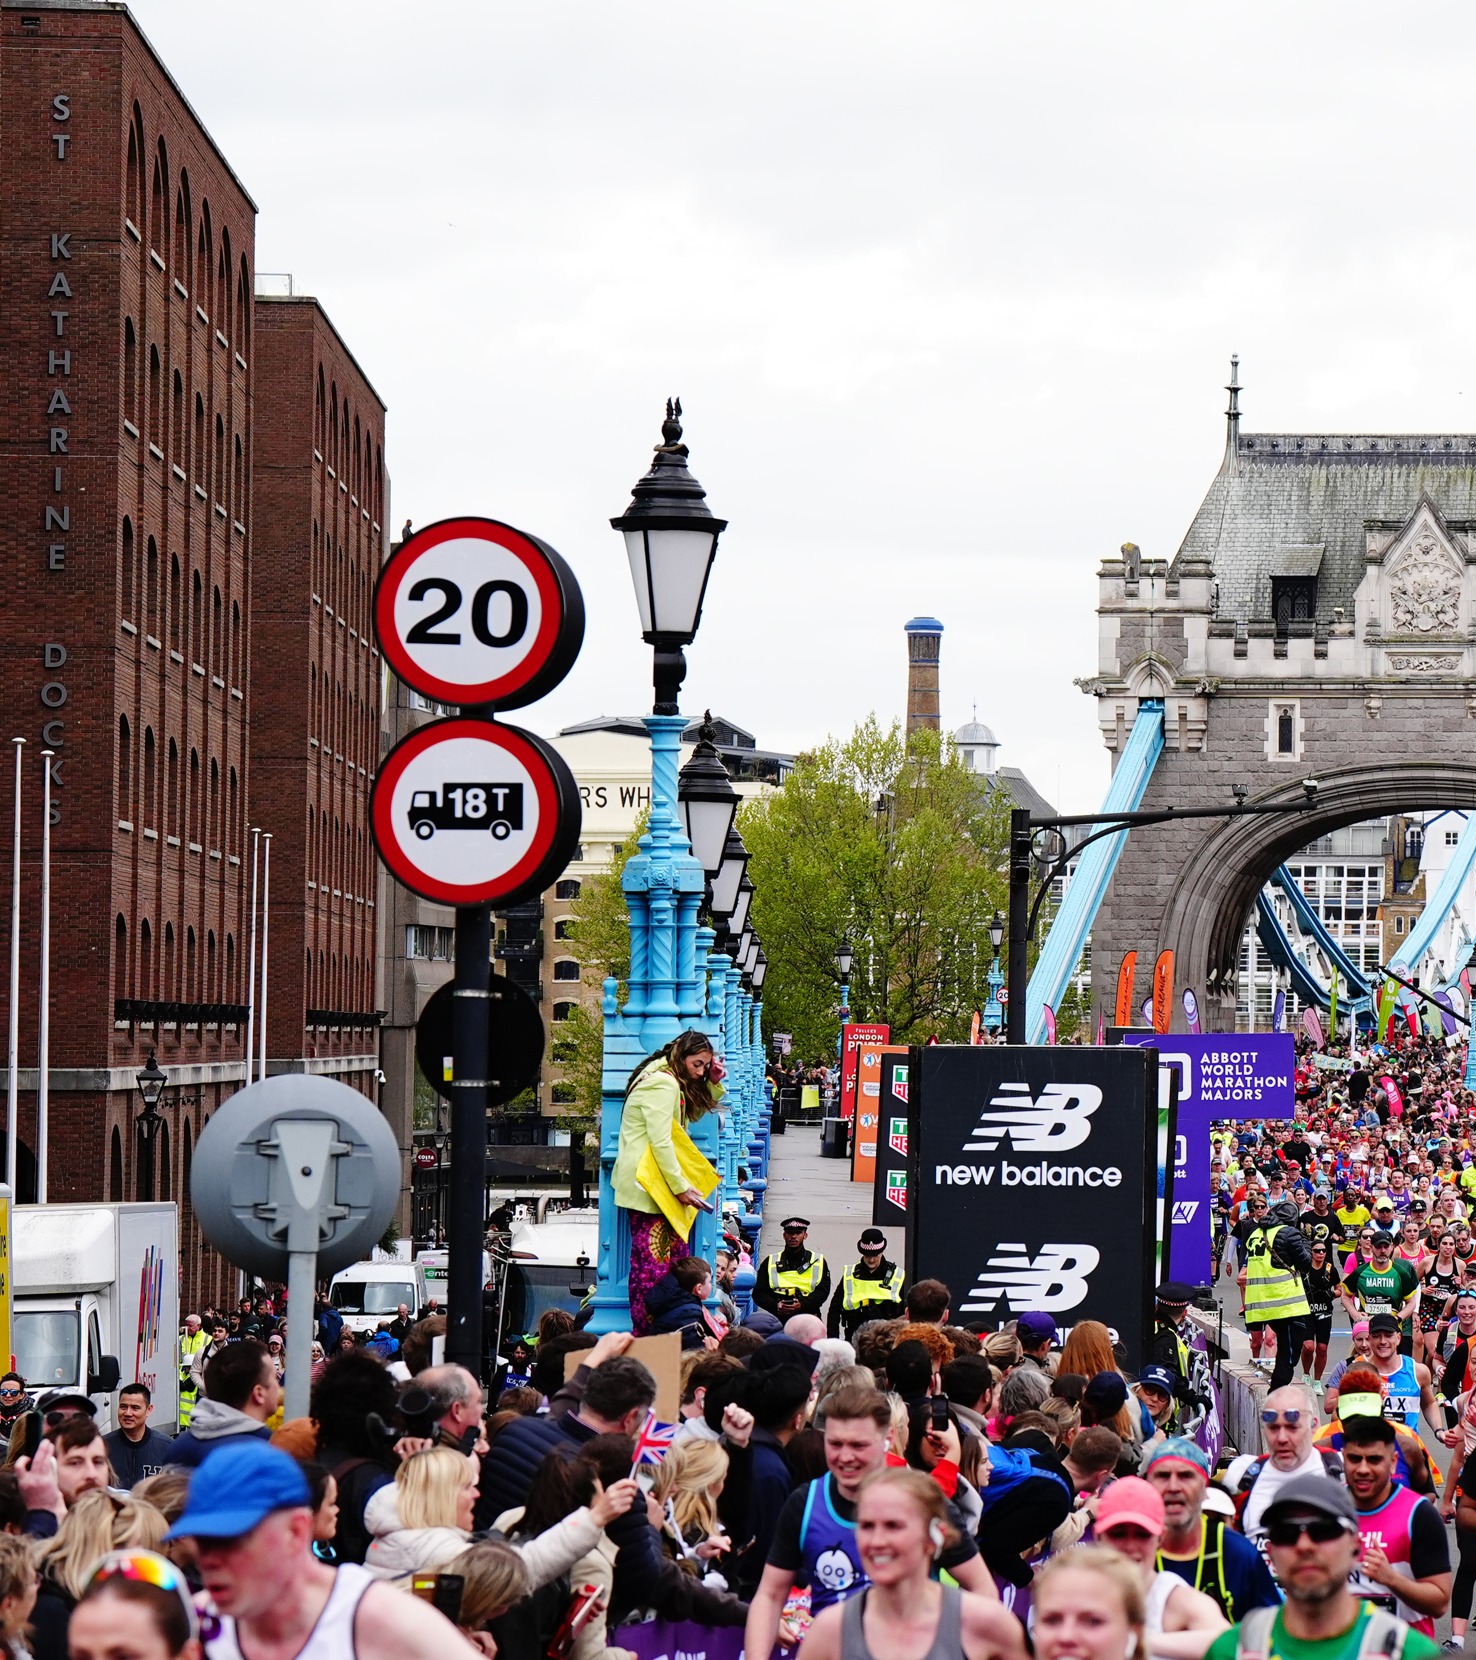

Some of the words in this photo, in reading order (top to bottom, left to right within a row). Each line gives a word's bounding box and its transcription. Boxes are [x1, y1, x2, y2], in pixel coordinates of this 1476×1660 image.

[52, 95, 70, 160] ST
[45, 233, 72, 571] KATHARINE
[406, 577, 529, 648] 20
[42, 643, 68, 825] DOCKS
[1201, 1052, 1258, 1063] ABBOTT
[1201, 1065, 1254, 1075] WORLD
[1201, 1077, 1288, 1088] MARATHON
[1201, 1089, 1263, 1100] MAJORS
[935, 1164, 995, 1186] new
[1001, 1160, 1122, 1187] balance
[1366, 1277, 1395, 1288] MARTIN
